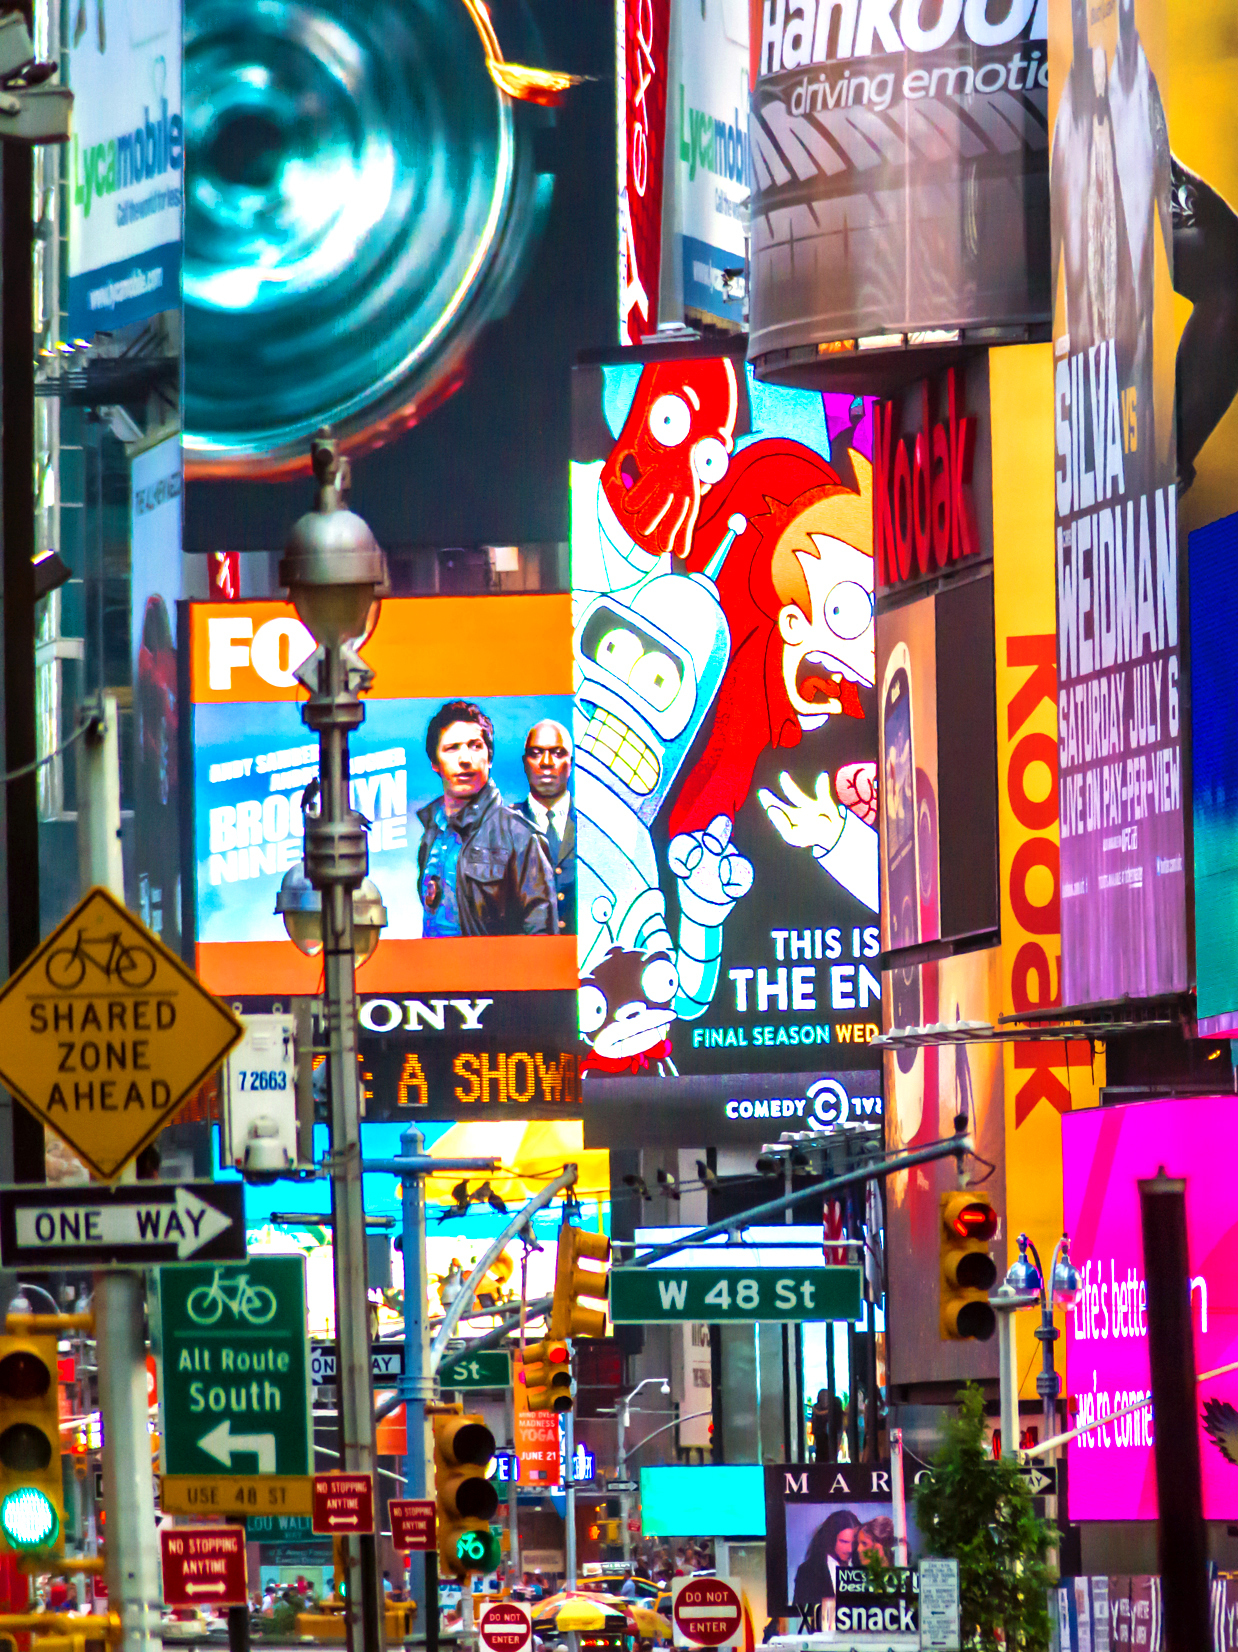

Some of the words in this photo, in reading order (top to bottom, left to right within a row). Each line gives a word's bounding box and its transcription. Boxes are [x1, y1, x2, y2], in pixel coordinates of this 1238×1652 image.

[760, 0, 1048, 76] Hankoo
[790, 71, 895, 117] driving
[680, 83, 749, 188] Lycamobi
[1056, 338, 1125, 517] SILVA
[1121, 386, 1137, 454] VS
[873, 367, 980, 587] Kodak
[1057, 484, 1178, 681] WEIDMAN
[208, 617, 319, 690] FO
[1059, 672, 1125, 769] SATURDAY
[1130, 659, 1163, 749] JULY
[1168, 655, 1179, 738] 6
[255, 743, 320, 774] SAMBER
[1060, 773, 1084, 839] LIVE
[1086, 767, 1100, 832] ON
[1103, 746, 1180, 828] PAY-PER-VIEW
[771, 927, 842, 961] THIS
[852, 926, 880, 959] IS
[728, 966, 817, 1012] THE
[830, 964, 882, 1010] EN
[30, 1000, 176, 1034] SHARED
[358, 998, 494, 1032] ONY
[692, 1028, 748, 1048] FINAL
[752, 1024, 831, 1046] SEASON
[835, 1023, 880, 1044] WED
[58, 1040, 150, 1073] ZONE
[397, 1053, 428, 1104] A
[46, 1079, 171, 1112] AHEAD
[725, 1100, 806, 1119] COMEDY
[35, 1211, 103, 1242] ONE
[136, 1208, 206, 1239] WAY
[658, 1280, 687, 1310] W
[704, 1279, 759, 1310] 48
[775, 1279, 816, 1310] St
[1111, 1258, 1147, 1339] bette
[179, 1348, 211, 1372] Alt
[222, 1349, 290, 1373] Route
[312, 1358, 335, 1373] ON
[373, 1357, 393, 1372] AY
[453, 1361, 480, 1380] St
[190, 1381, 282, 1412] South
[1114, 1390, 1154, 1448] conne
[519, 1429, 555, 1441] YOGA
[520, 1452, 543, 1460] JUNE
[546, 1452, 557, 1460] 21
[187, 1487, 219, 1505] USE
[235, 1487, 257, 1506] 48
[268, 1487, 286, 1505] ST
[316, 1482, 327, 1494] NO
[331, 1482, 367, 1494] STOPPING
[327, 1498, 359, 1510] ANYTIME
[394, 1508, 403, 1517] NO
[405, 1507, 433, 1517] STOPPING
[402, 1521, 427, 1530] ANYTIME
[168, 1538, 184, 1555] NO
[189, 1537, 238, 1554] STOPPING
[182, 1559, 227, 1575] ANYTIME
[685, 1592, 700, 1602] DO
[706, 1591, 729, 1602] NOT
[504, 1613, 521, 1621] NOT
[690, 1622, 727, 1633] ENTER
[836, 1599, 917, 1631] snack
[492, 1636, 519, 1644] ENTER
